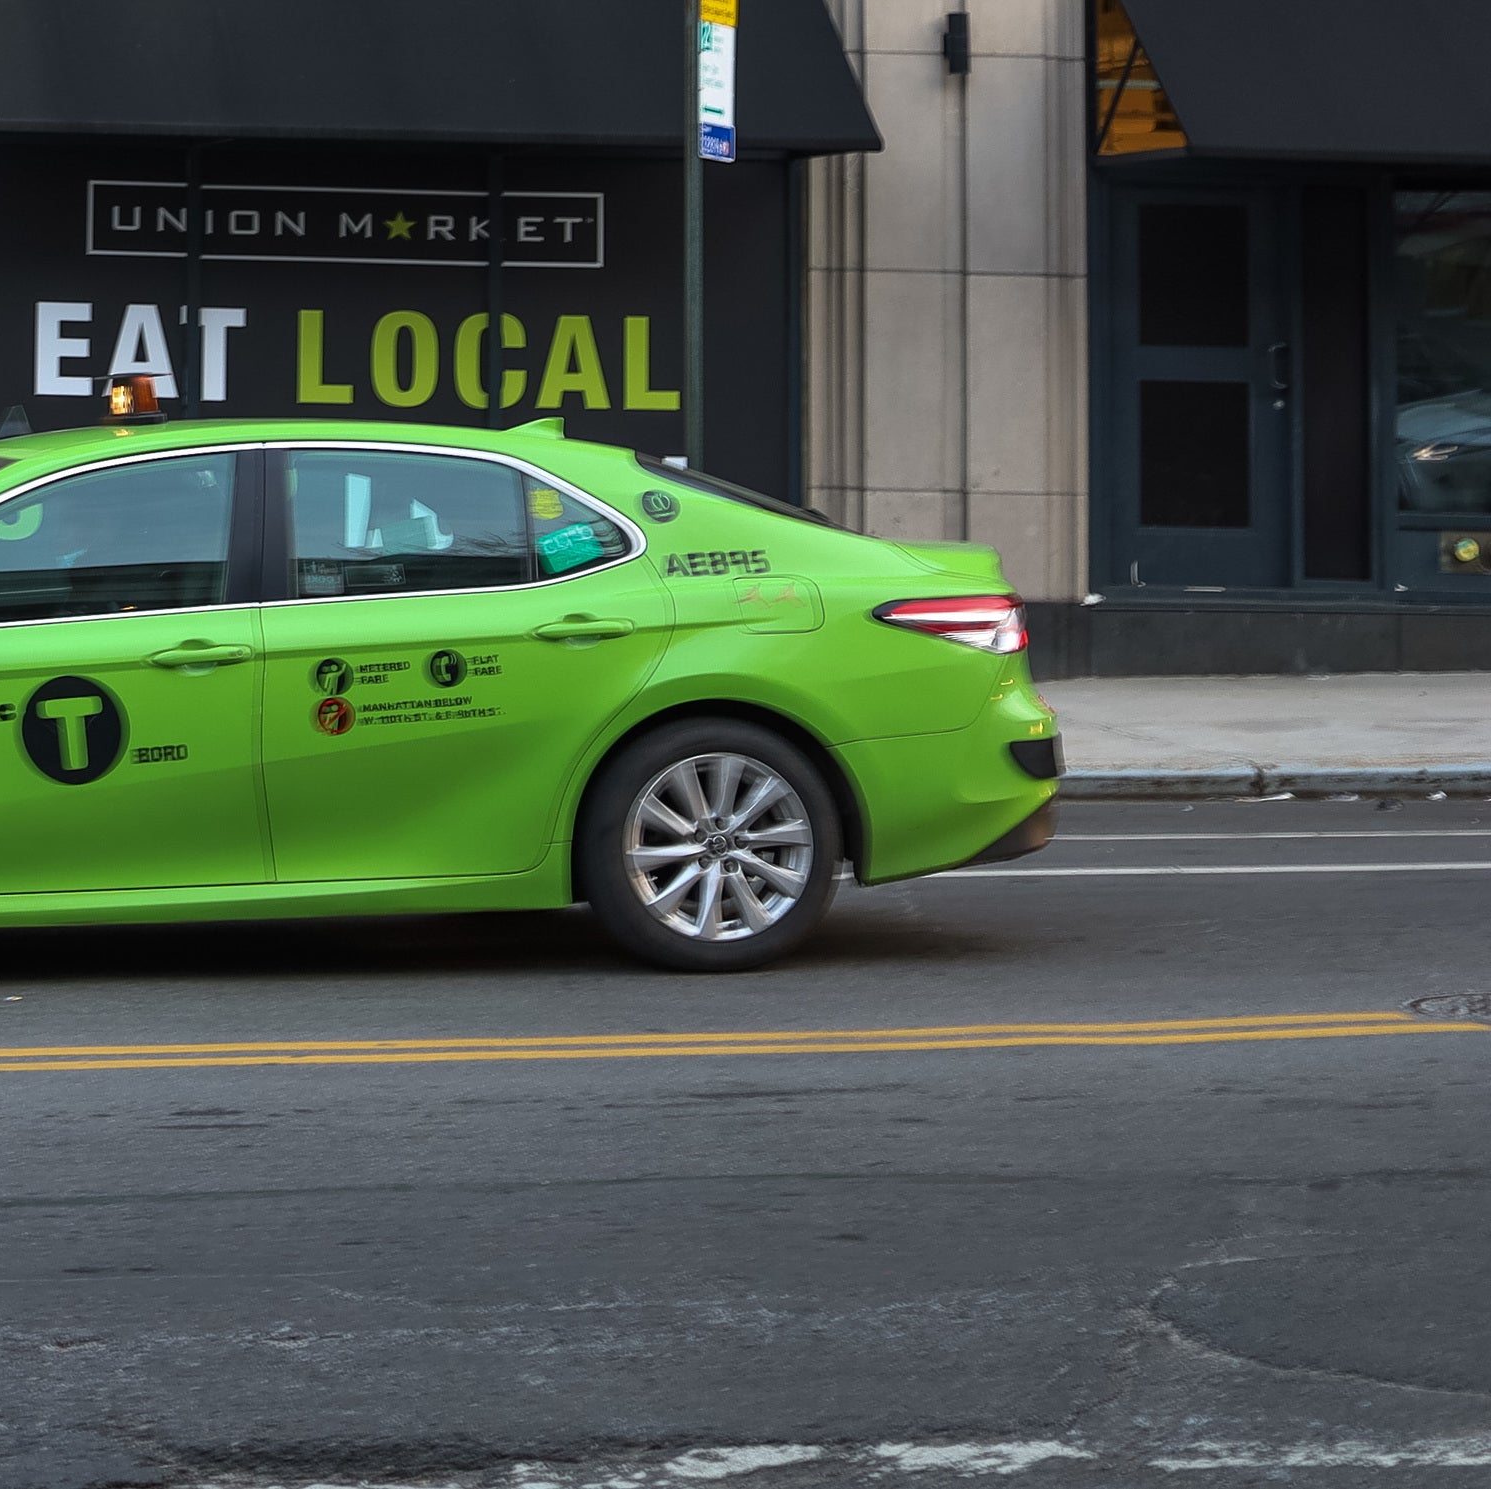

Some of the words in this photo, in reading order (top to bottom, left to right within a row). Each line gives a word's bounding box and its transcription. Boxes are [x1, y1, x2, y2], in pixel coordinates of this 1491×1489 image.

[111, 205, 307, 237] UNION
[34, 301, 247, 402] EAT
[296, 309, 681, 411] LOCAL
[472, 654, 500, 665] FLAT
[357, 661, 411, 673] METERED
[473, 665, 503, 676] FARE
[359, 673, 390, 684] FARE
[361, 698, 432, 712] MANHATTAN
[135, 743, 189, 764] BORO
